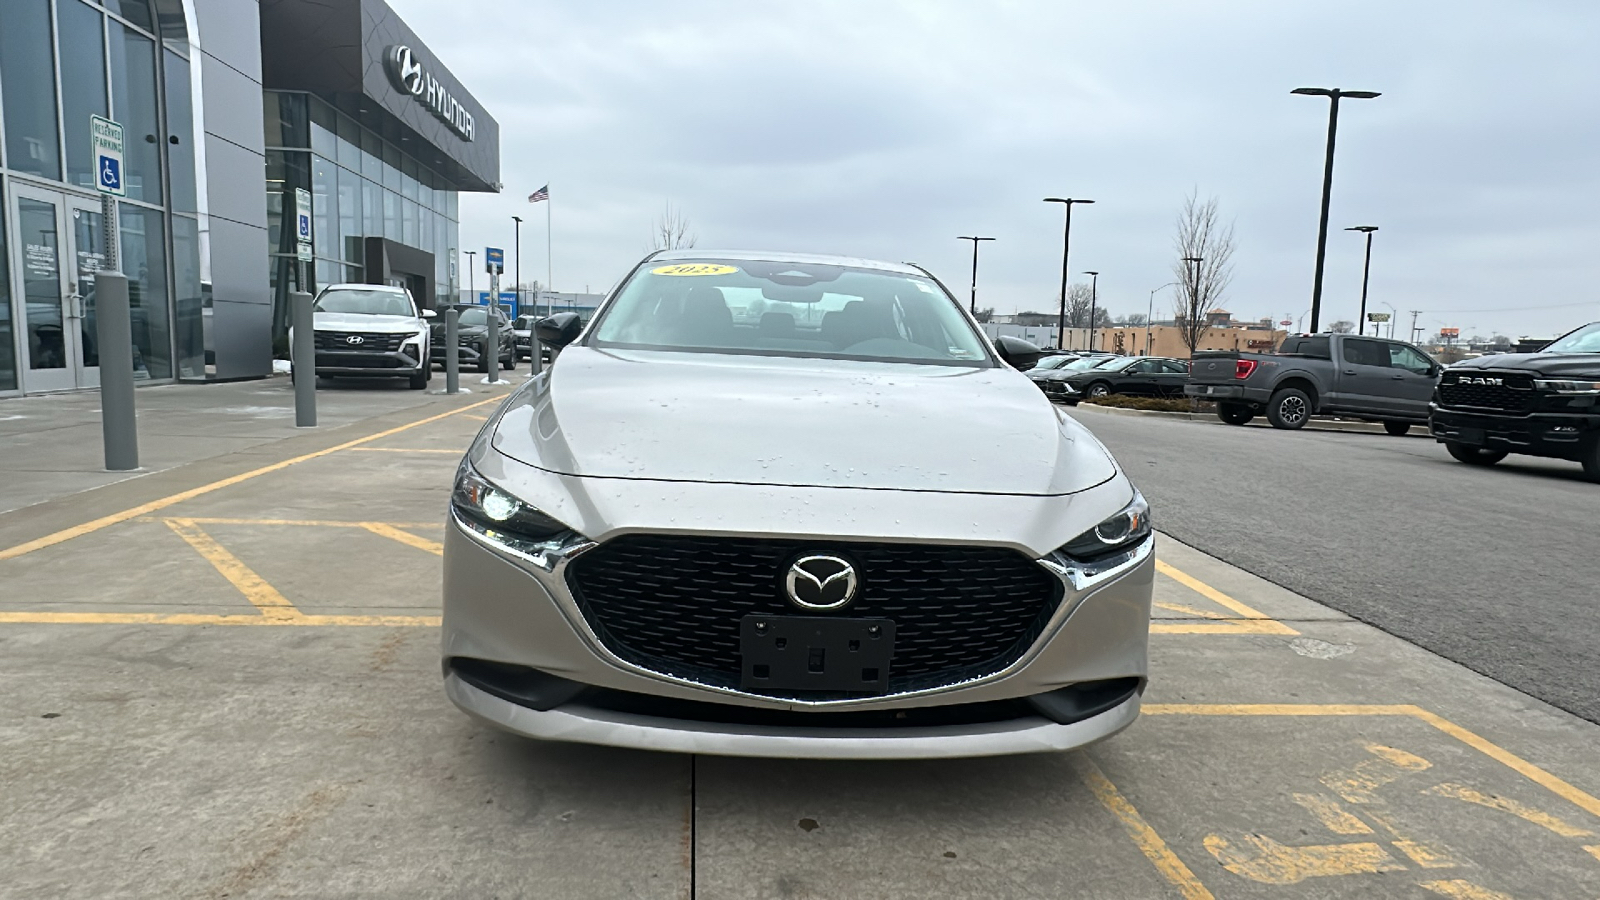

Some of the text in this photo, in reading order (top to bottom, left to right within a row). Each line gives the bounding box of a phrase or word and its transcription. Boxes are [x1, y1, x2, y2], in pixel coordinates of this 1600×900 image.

[426, 71, 475, 143] HYUNDAI
[94, 122, 121, 141] RESERVED
[94, 135, 122, 154] PARKING
[1458, 376, 1504, 386] RAM
